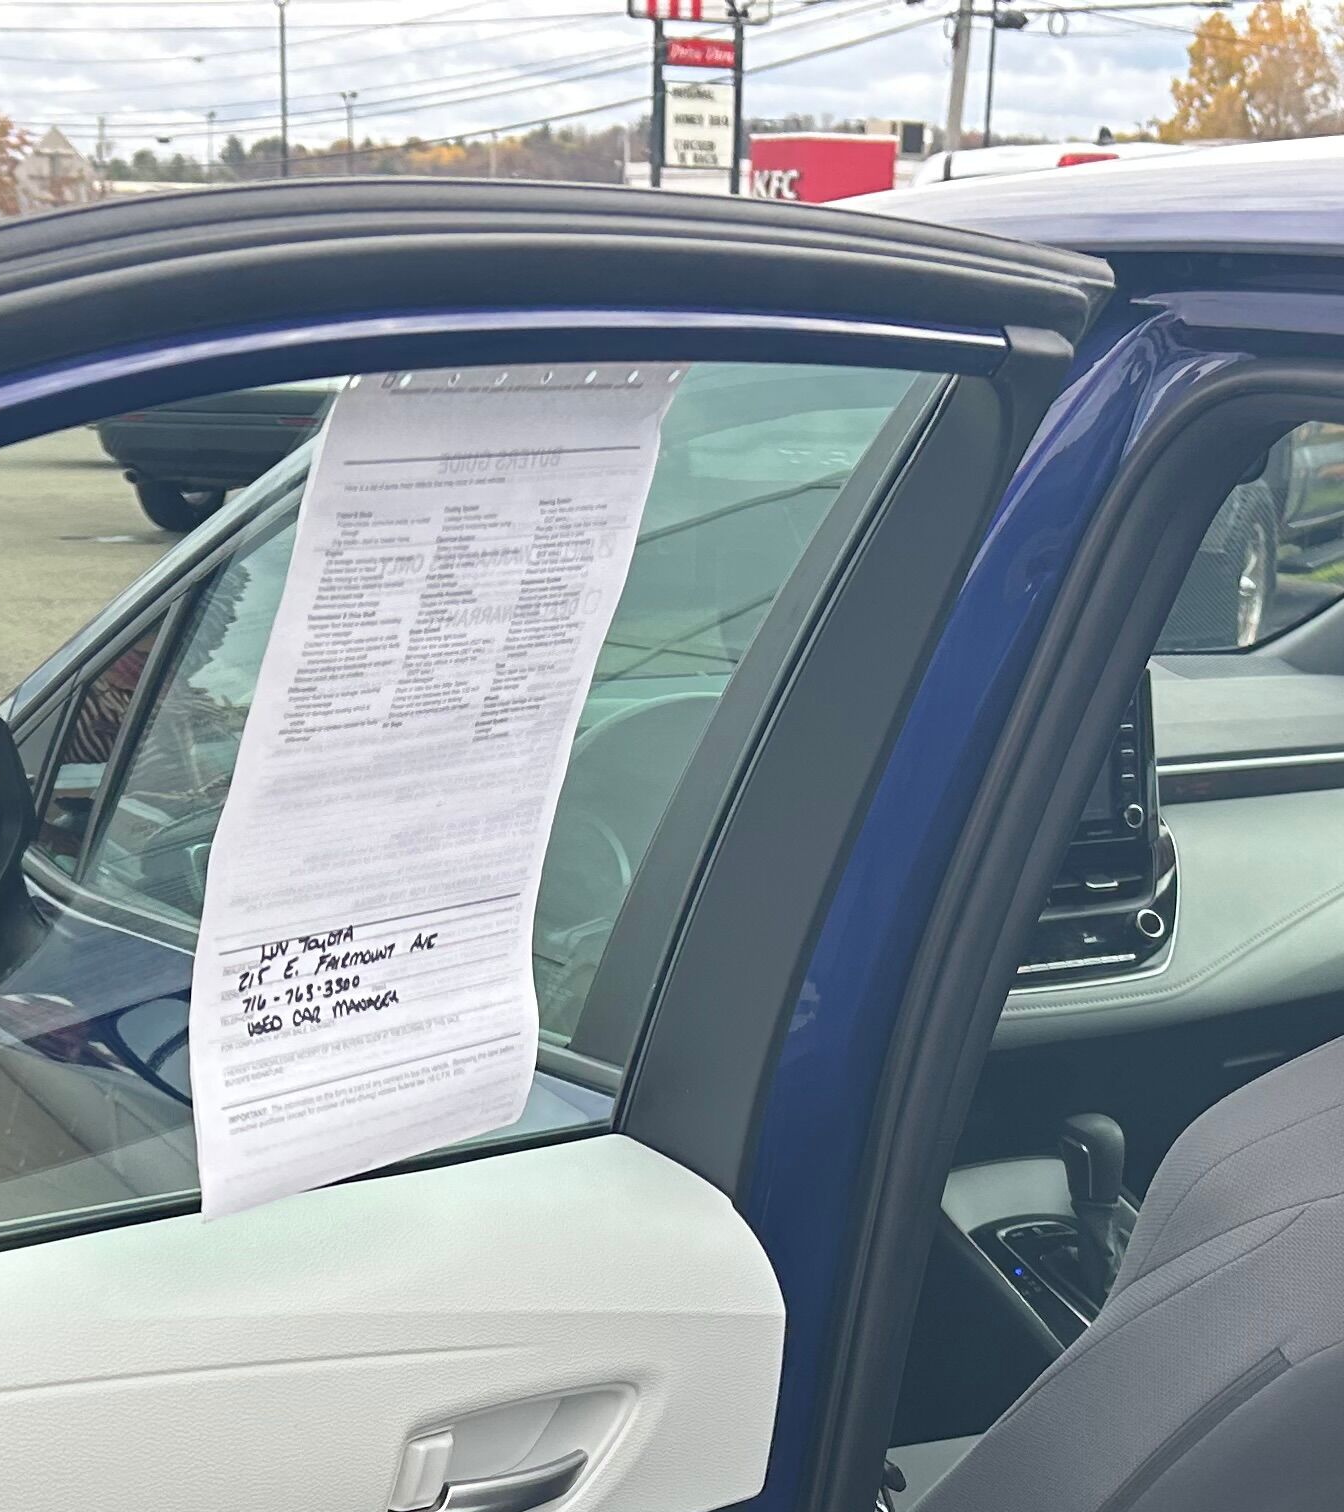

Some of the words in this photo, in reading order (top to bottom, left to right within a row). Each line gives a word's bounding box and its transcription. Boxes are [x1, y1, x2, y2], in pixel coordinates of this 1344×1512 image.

[752, 168, 800, 201] KFC
[238, 965, 271, 993] 215
[283, 956, 299, 980] E.
[314, 943, 396, 975] FAIRMOUNT
[260, 941, 289, 963] LUV
[247, 1014, 283, 1038] USED
[292, 1005, 321, 1026] CAR
[332, 989, 400, 1019] MANAGER
